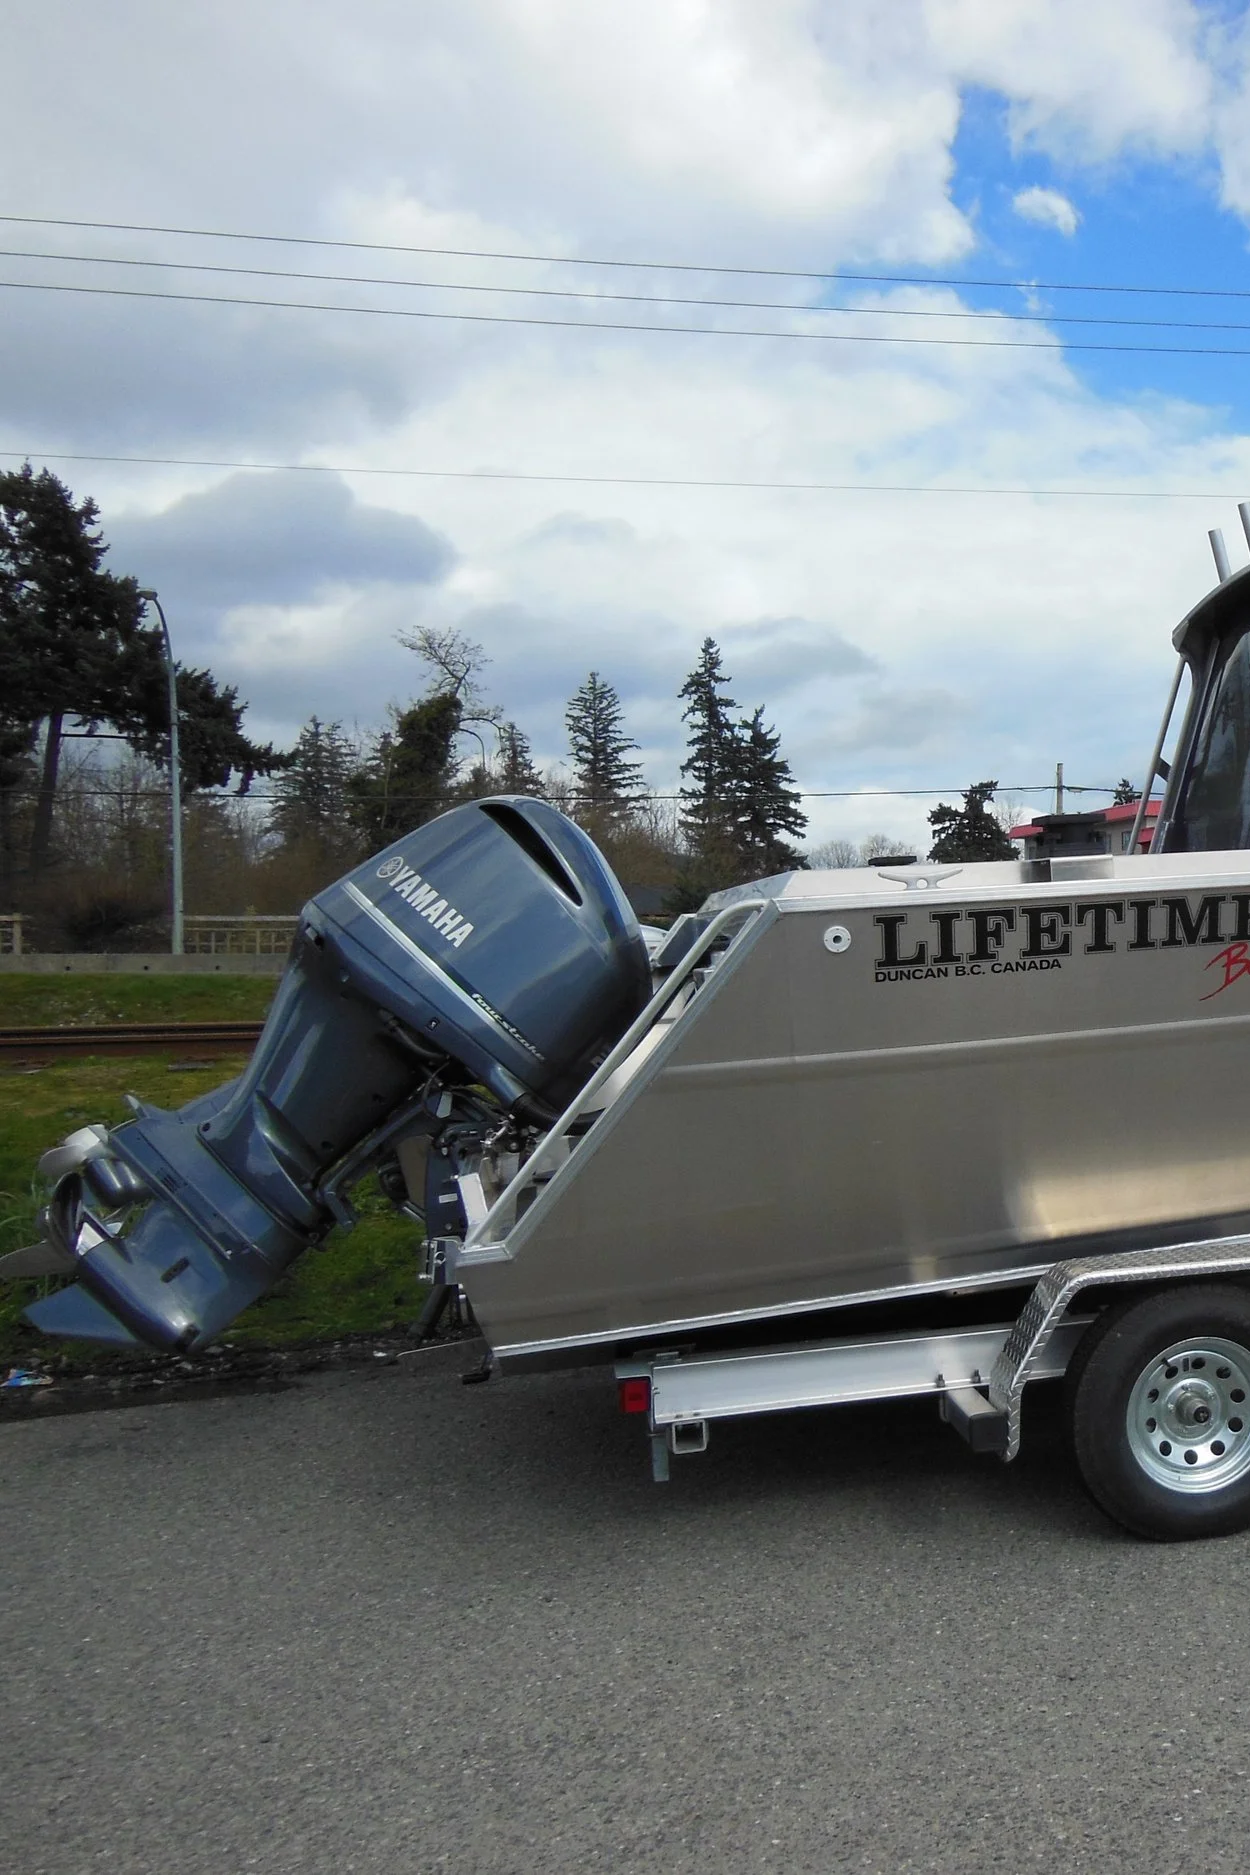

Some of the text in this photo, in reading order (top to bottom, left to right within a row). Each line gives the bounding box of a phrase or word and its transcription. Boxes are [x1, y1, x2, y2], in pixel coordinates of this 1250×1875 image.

[388, 865, 475, 948] YAMAHA
[875, 958, 1062, 983] DUNCAN B.C. CANADA
